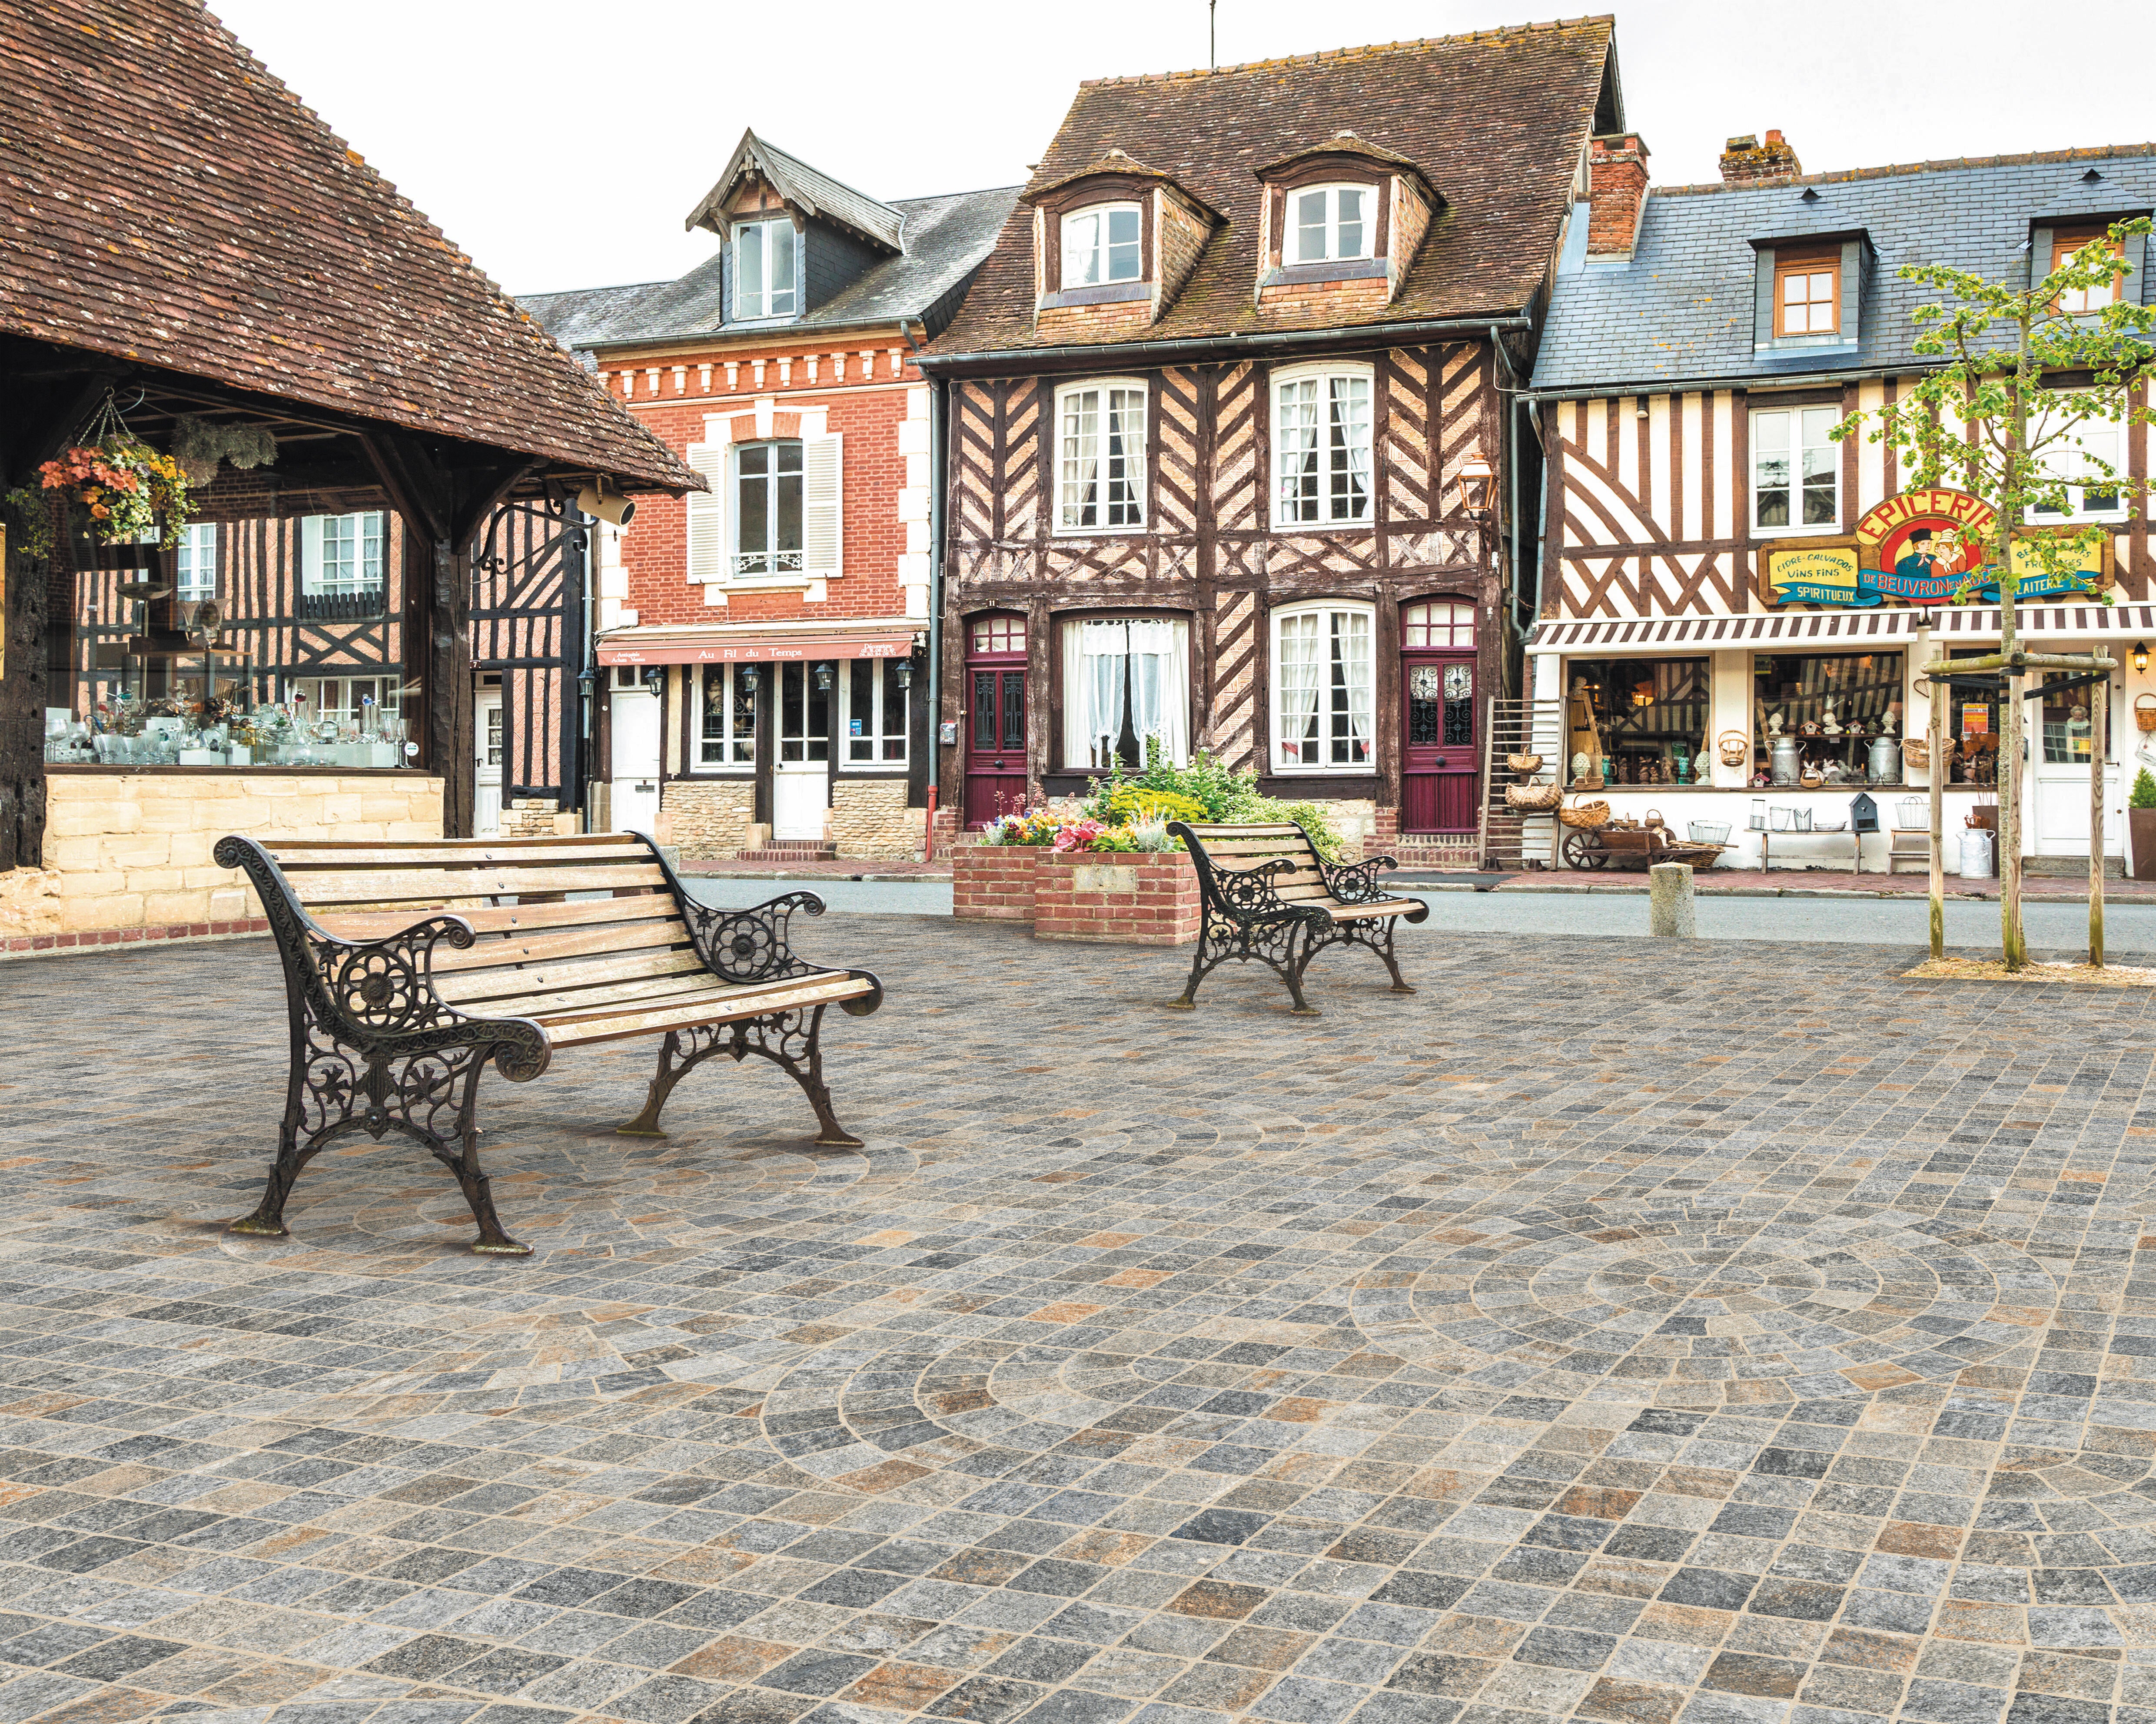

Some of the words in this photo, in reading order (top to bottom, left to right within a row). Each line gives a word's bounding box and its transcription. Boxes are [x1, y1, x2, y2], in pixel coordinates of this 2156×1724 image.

[1857, 491, 1995, 539] EPICERIE
[1863, 574, 1875, 584] DE
[1877, 574, 1949, 595] BEUVRON
[1950, 580, 1962, 590] EN
[1962, 567, 1999, 587] AUG
[1797, 587, 1854, 602] SPIRITUEUX
[698, 650, 714, 659] Au
[724, 649, 737, 658] Fil
[745, 649, 759, 657] du
[768, 648, 802, 657] Temps
